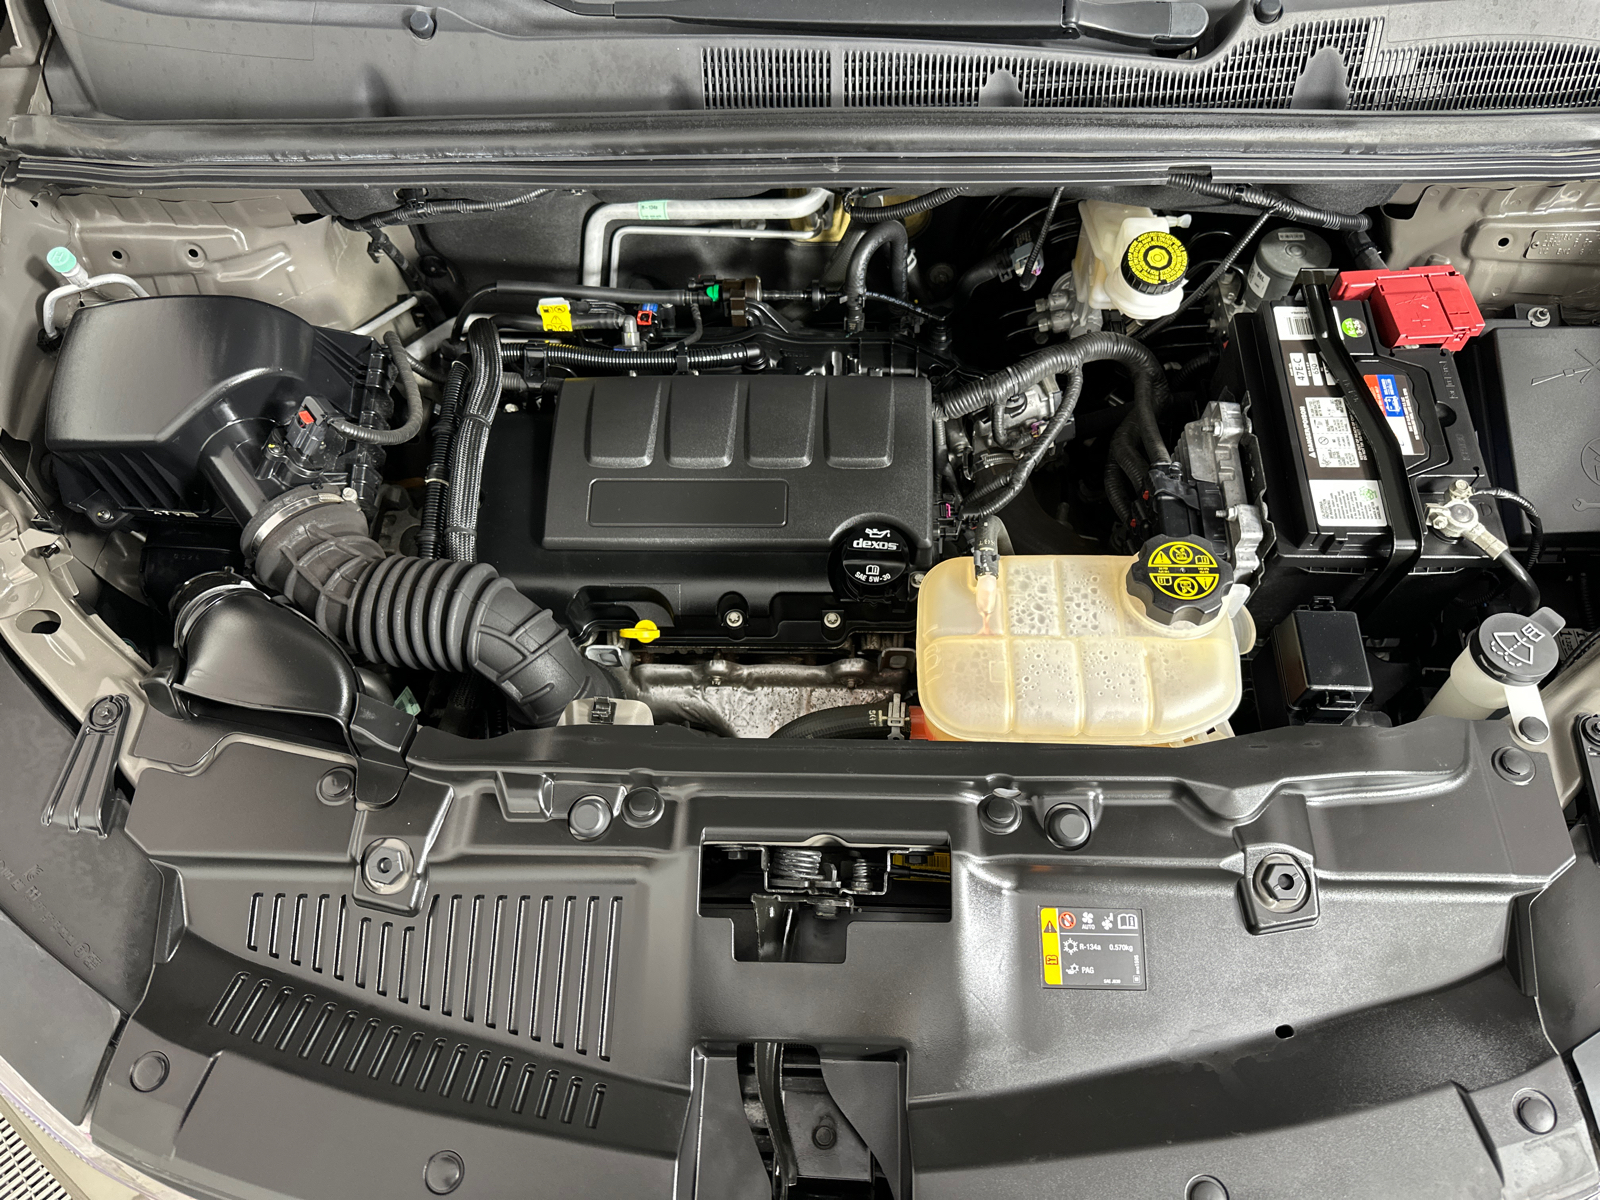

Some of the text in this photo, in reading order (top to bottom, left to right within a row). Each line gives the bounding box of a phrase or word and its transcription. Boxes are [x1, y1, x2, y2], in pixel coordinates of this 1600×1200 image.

[1293, 358, 1305, 381] 47E-C
[1312, 363, 1320, 375] 650
[1299, 406, 1316, 452] DANGER/POISON
[853, 538, 897, 550] dexos
[854, 571, 891, 583] SAE 5W-30
[1079, 943, 1134, 952] R-134a 0.570kg
[1081, 966, 1095, 974] PAG
